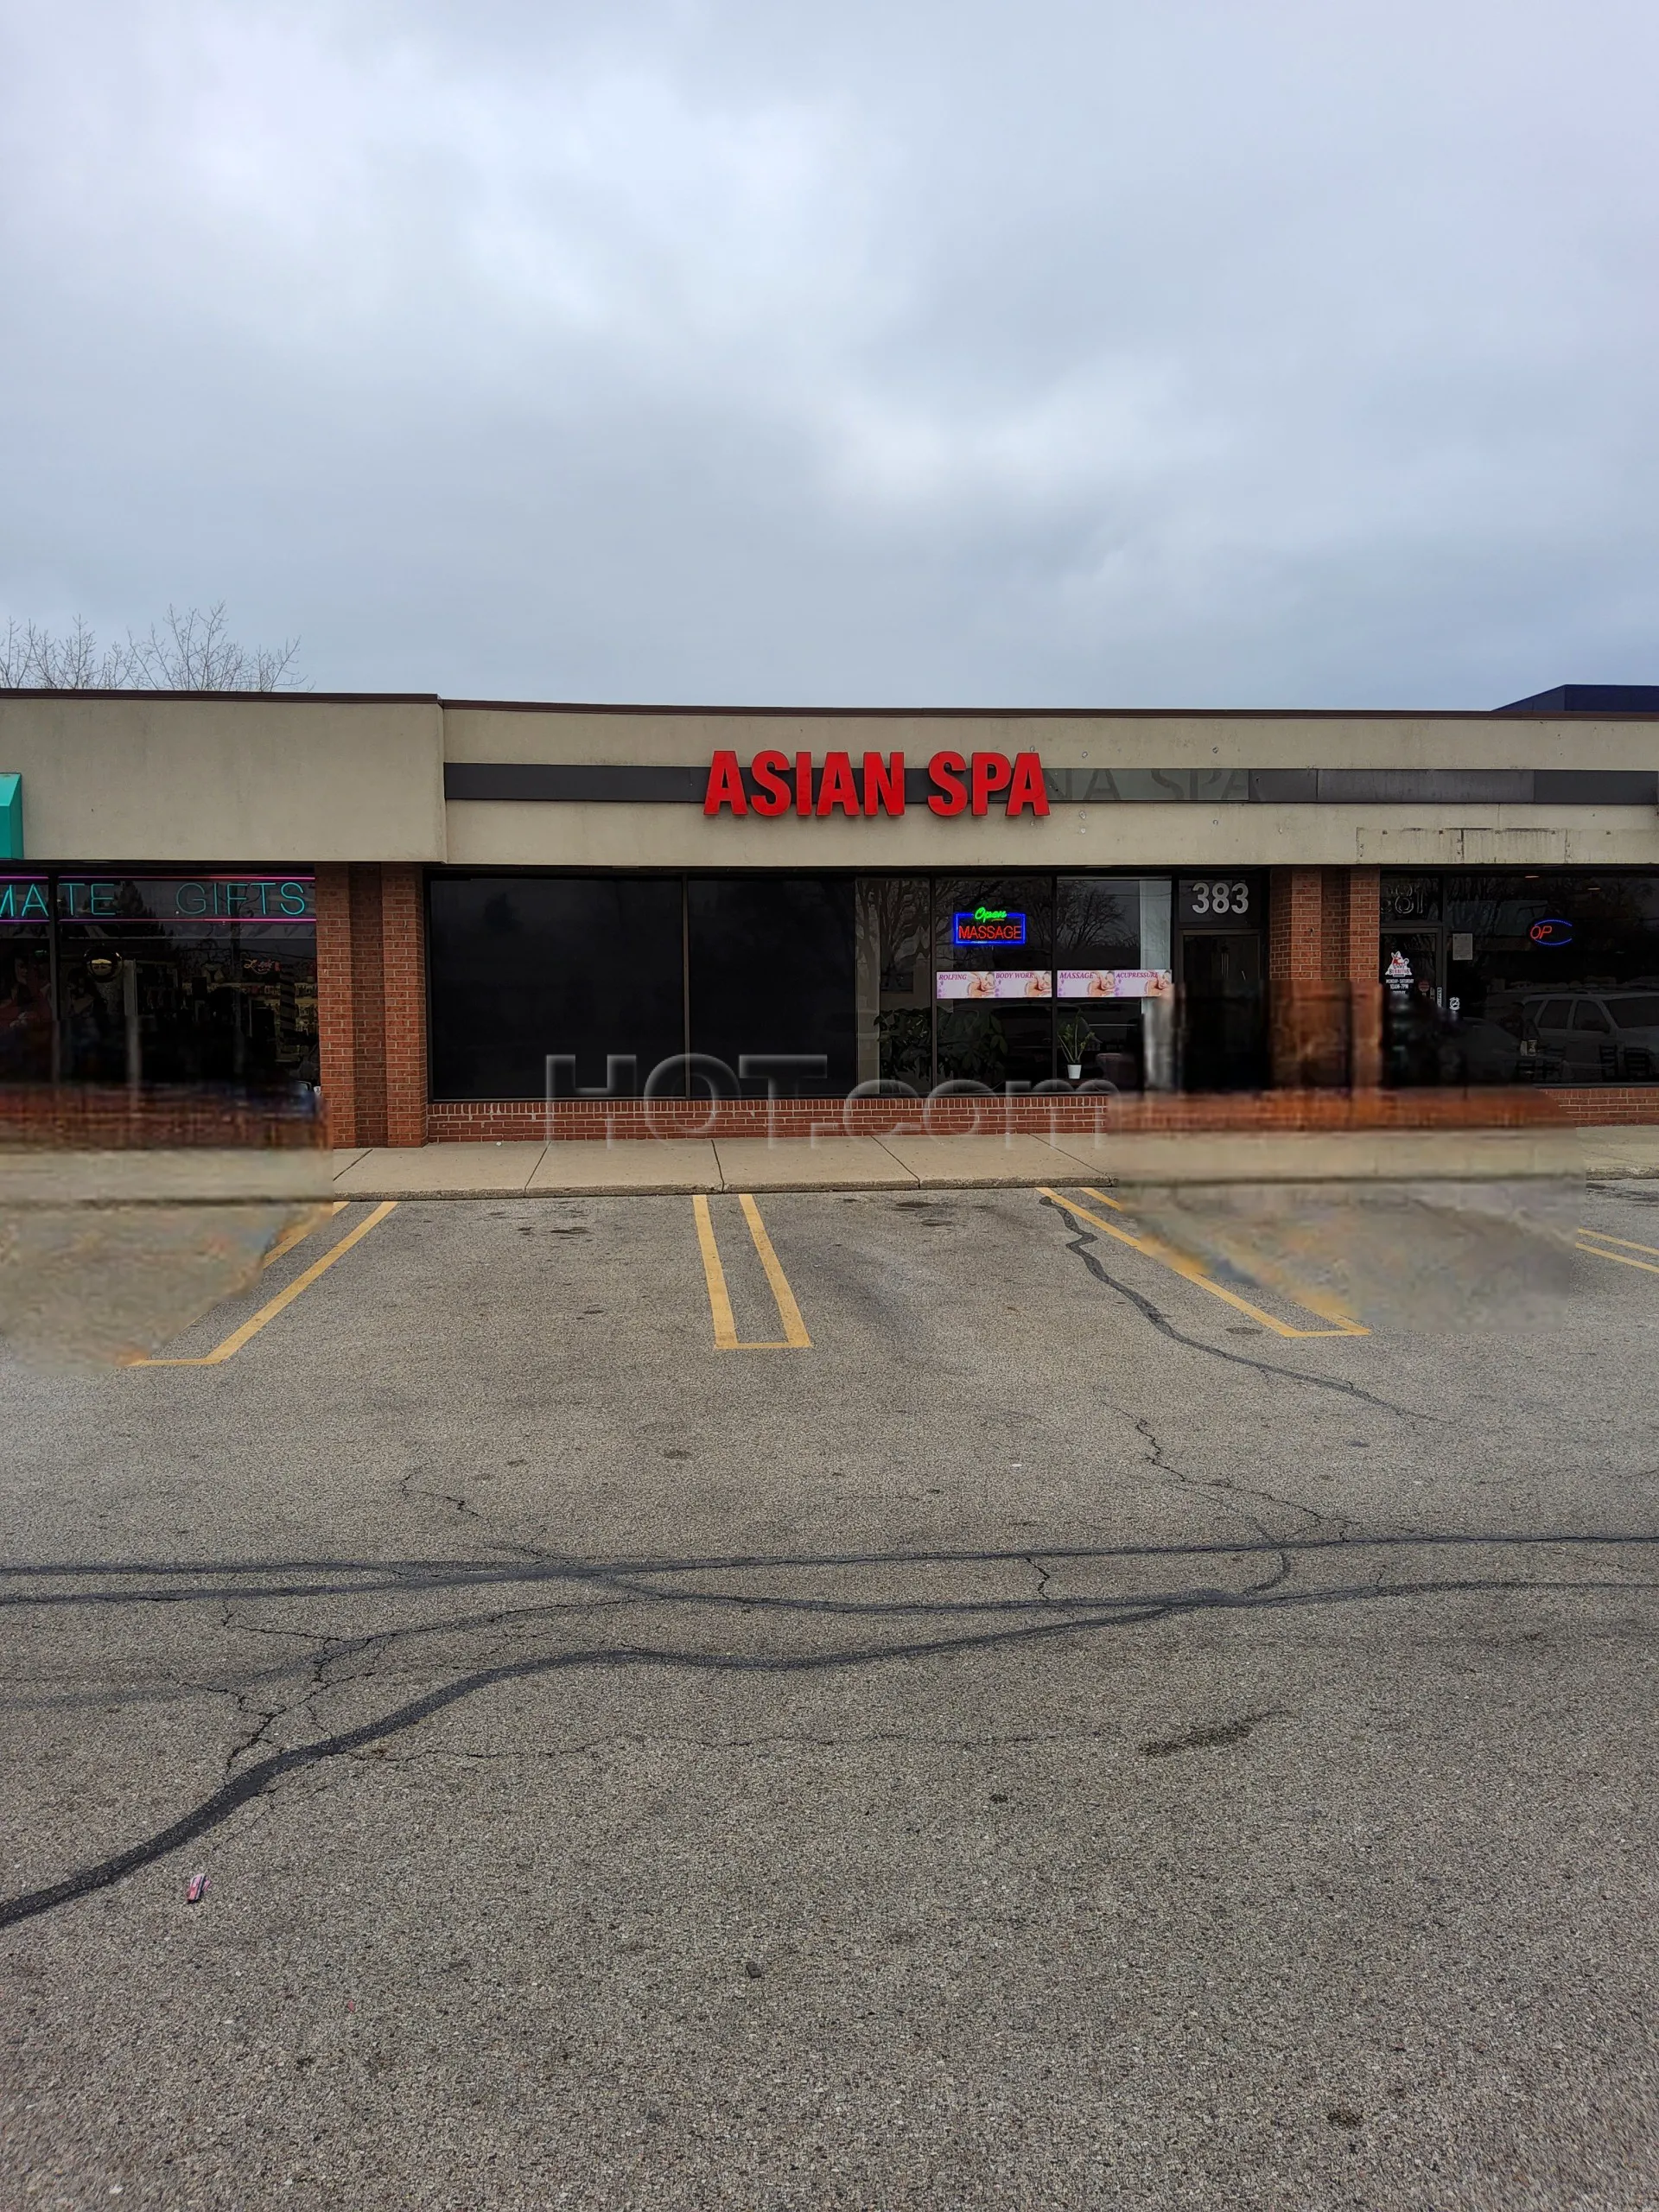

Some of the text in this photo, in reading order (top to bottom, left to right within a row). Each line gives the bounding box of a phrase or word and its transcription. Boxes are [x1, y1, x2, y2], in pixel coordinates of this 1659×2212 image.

[703, 750, 1051, 817] ASIAN SPA
[176, 881, 305, 916] GIFTS
[1192, 882, 1249, 914] 383
[975, 906, 1007, 923] Open
[958, 925, 1022, 939] MASSAGE
[1530, 925, 1553, 940] OP
